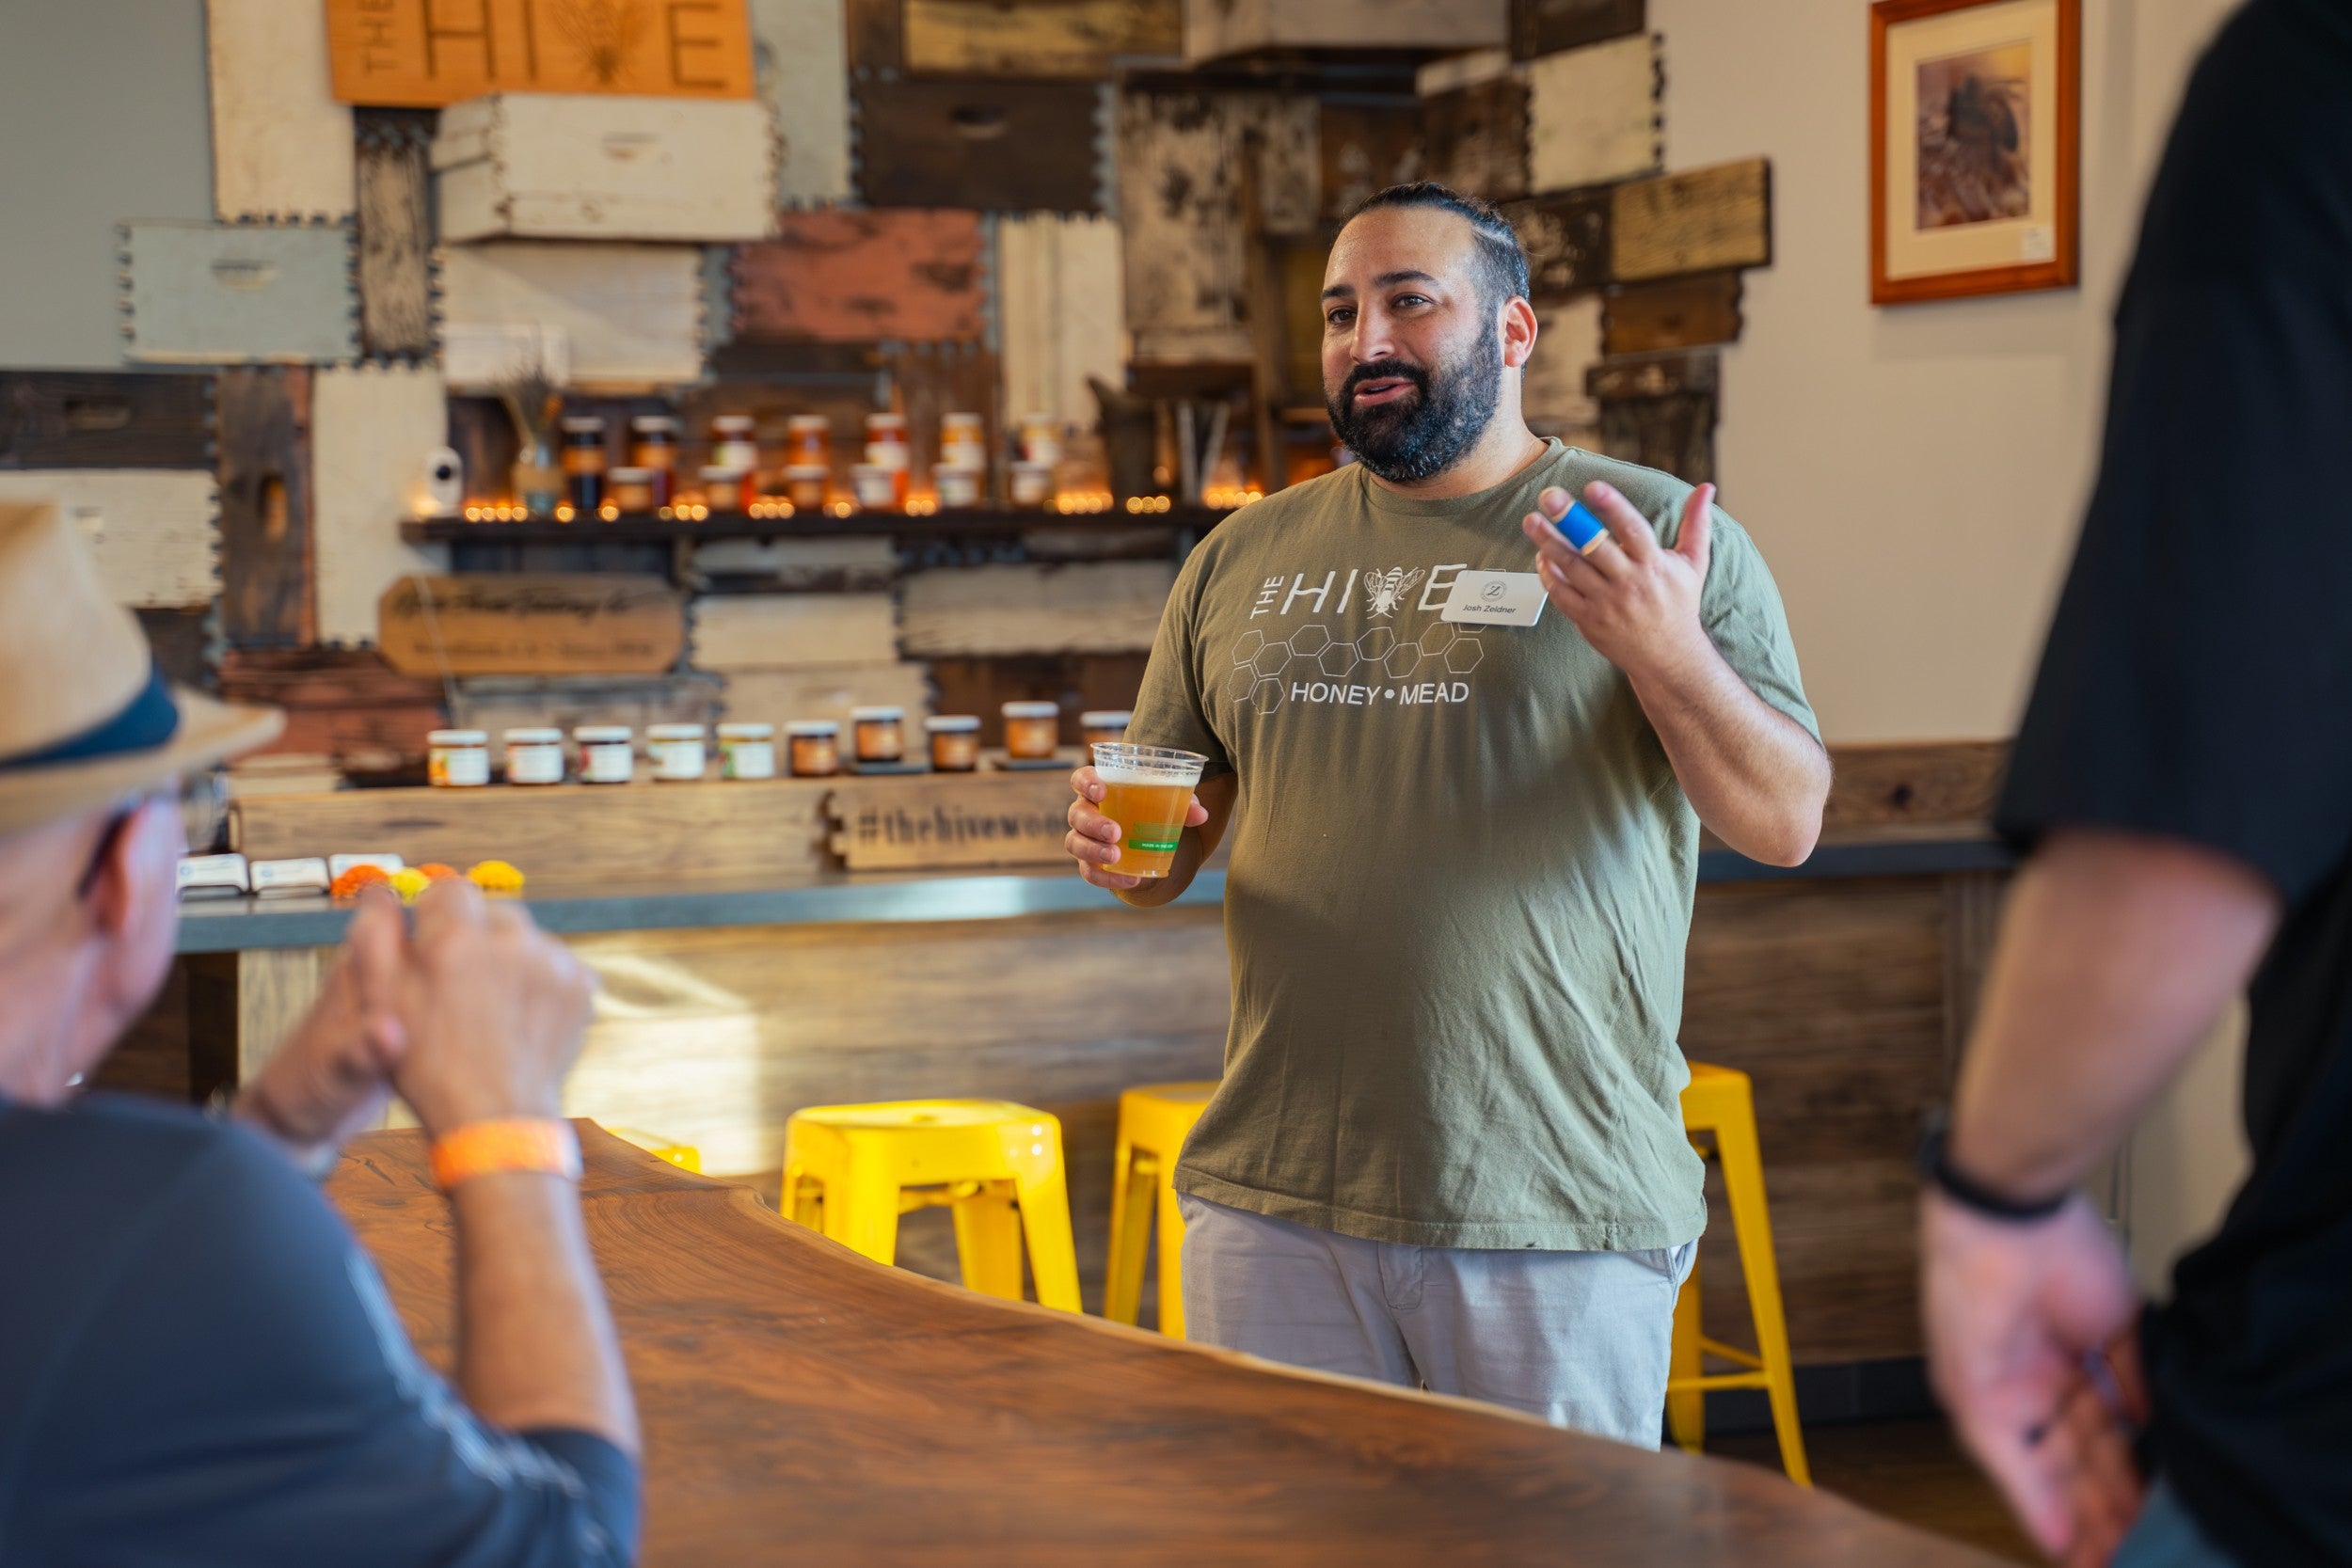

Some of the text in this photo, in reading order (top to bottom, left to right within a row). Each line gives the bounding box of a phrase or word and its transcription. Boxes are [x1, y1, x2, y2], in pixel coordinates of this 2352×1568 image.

[1249, 575, 1285, 620] THE
[1463, 604, 1482, 612] Josh
[1291, 682, 1470, 705] HONEY MEAD
